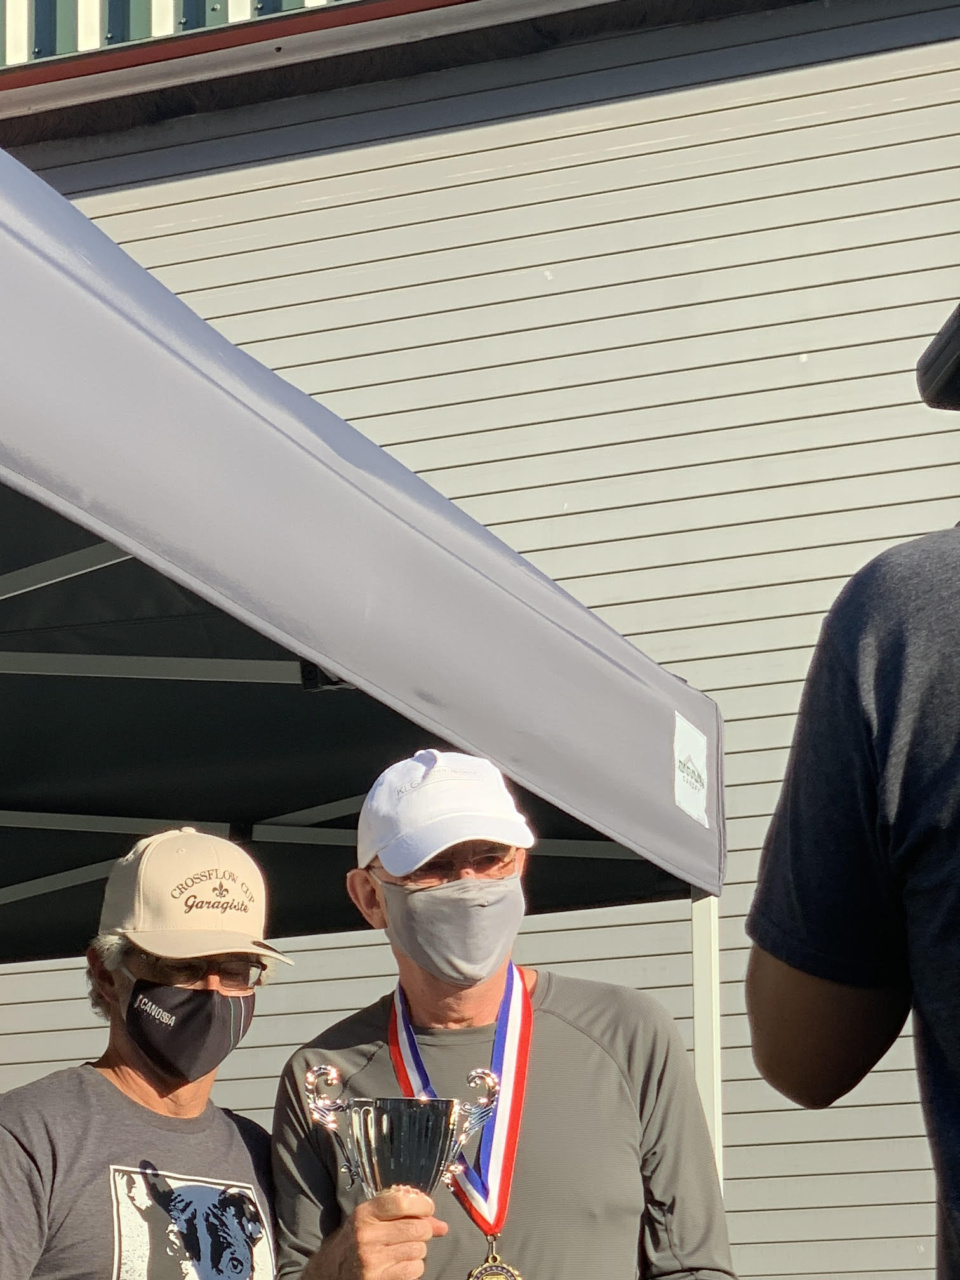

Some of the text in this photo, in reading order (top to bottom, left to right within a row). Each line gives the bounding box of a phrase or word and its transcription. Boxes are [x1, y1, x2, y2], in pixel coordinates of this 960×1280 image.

[170, 868, 255, 903] CROSSFLOW CUP
[184, 894, 249, 914] Garagiste
[140, 998, 176, 1027] CANOSSA
